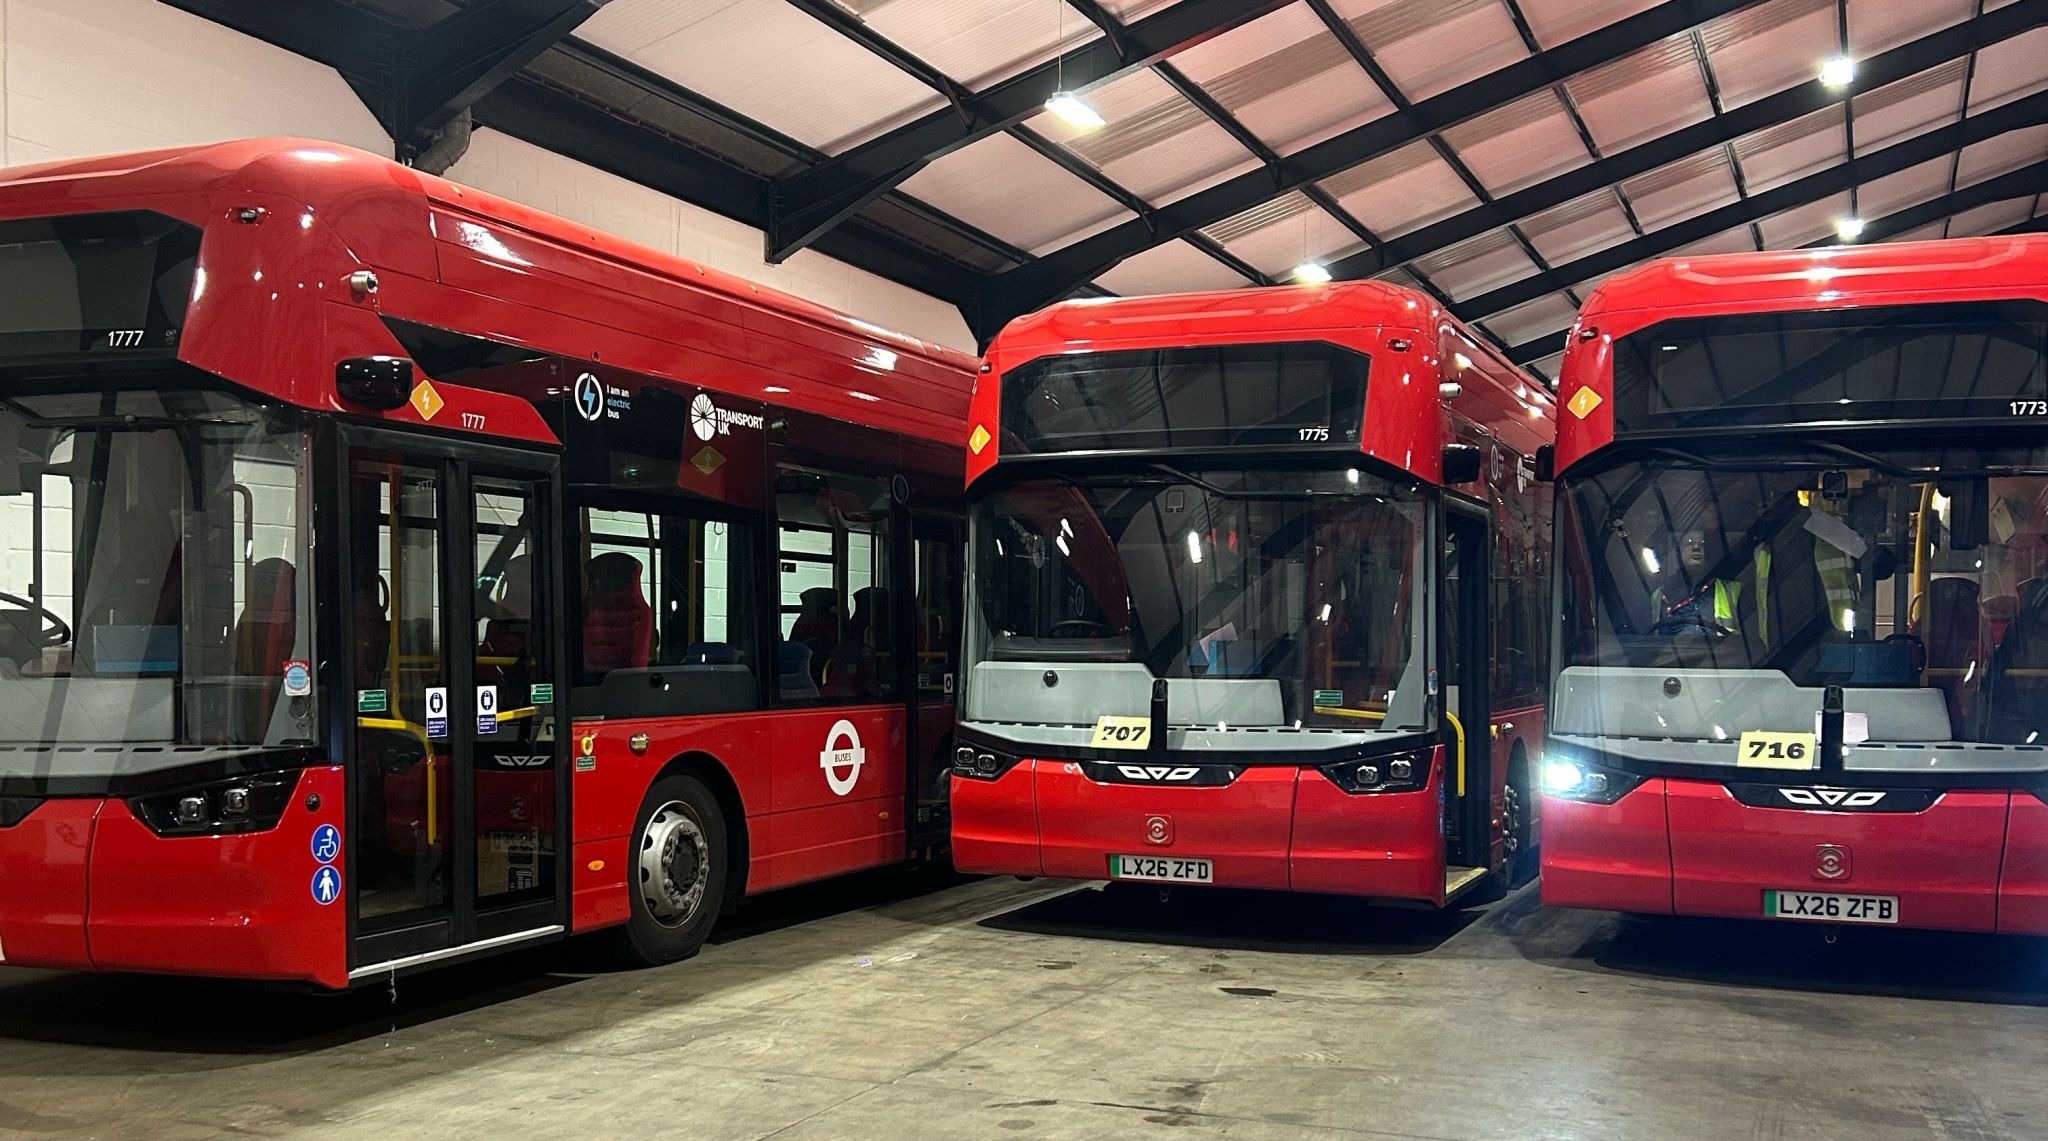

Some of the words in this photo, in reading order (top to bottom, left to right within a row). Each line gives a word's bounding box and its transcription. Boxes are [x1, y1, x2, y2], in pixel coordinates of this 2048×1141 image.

[108, 330, 144, 347] 1777
[606, 384, 610, 394] I
[610, 387, 621, 396] am
[621, 389, 630, 398] an
[607, 397, 631, 410] electric
[2009, 401, 2048, 415] 1773
[607, 407, 620, 419] bus
[716, 407, 764, 430] TRANSPORT
[461, 412, 486, 430] 1777
[718, 422, 731, 436] UK
[1298, 428, 1329, 441] 1775
[1101, 726, 1147, 741] 707
[1748, 741, 1806, 759] 716
[834, 753, 852, 763] BUSES
[1122, 857, 1168, 877] LX26
[1173, 860, 1208, 879] ZFD
[1780, 895, 1840, 916] LX26
[1847, 898, 1892, 919] ZFB
